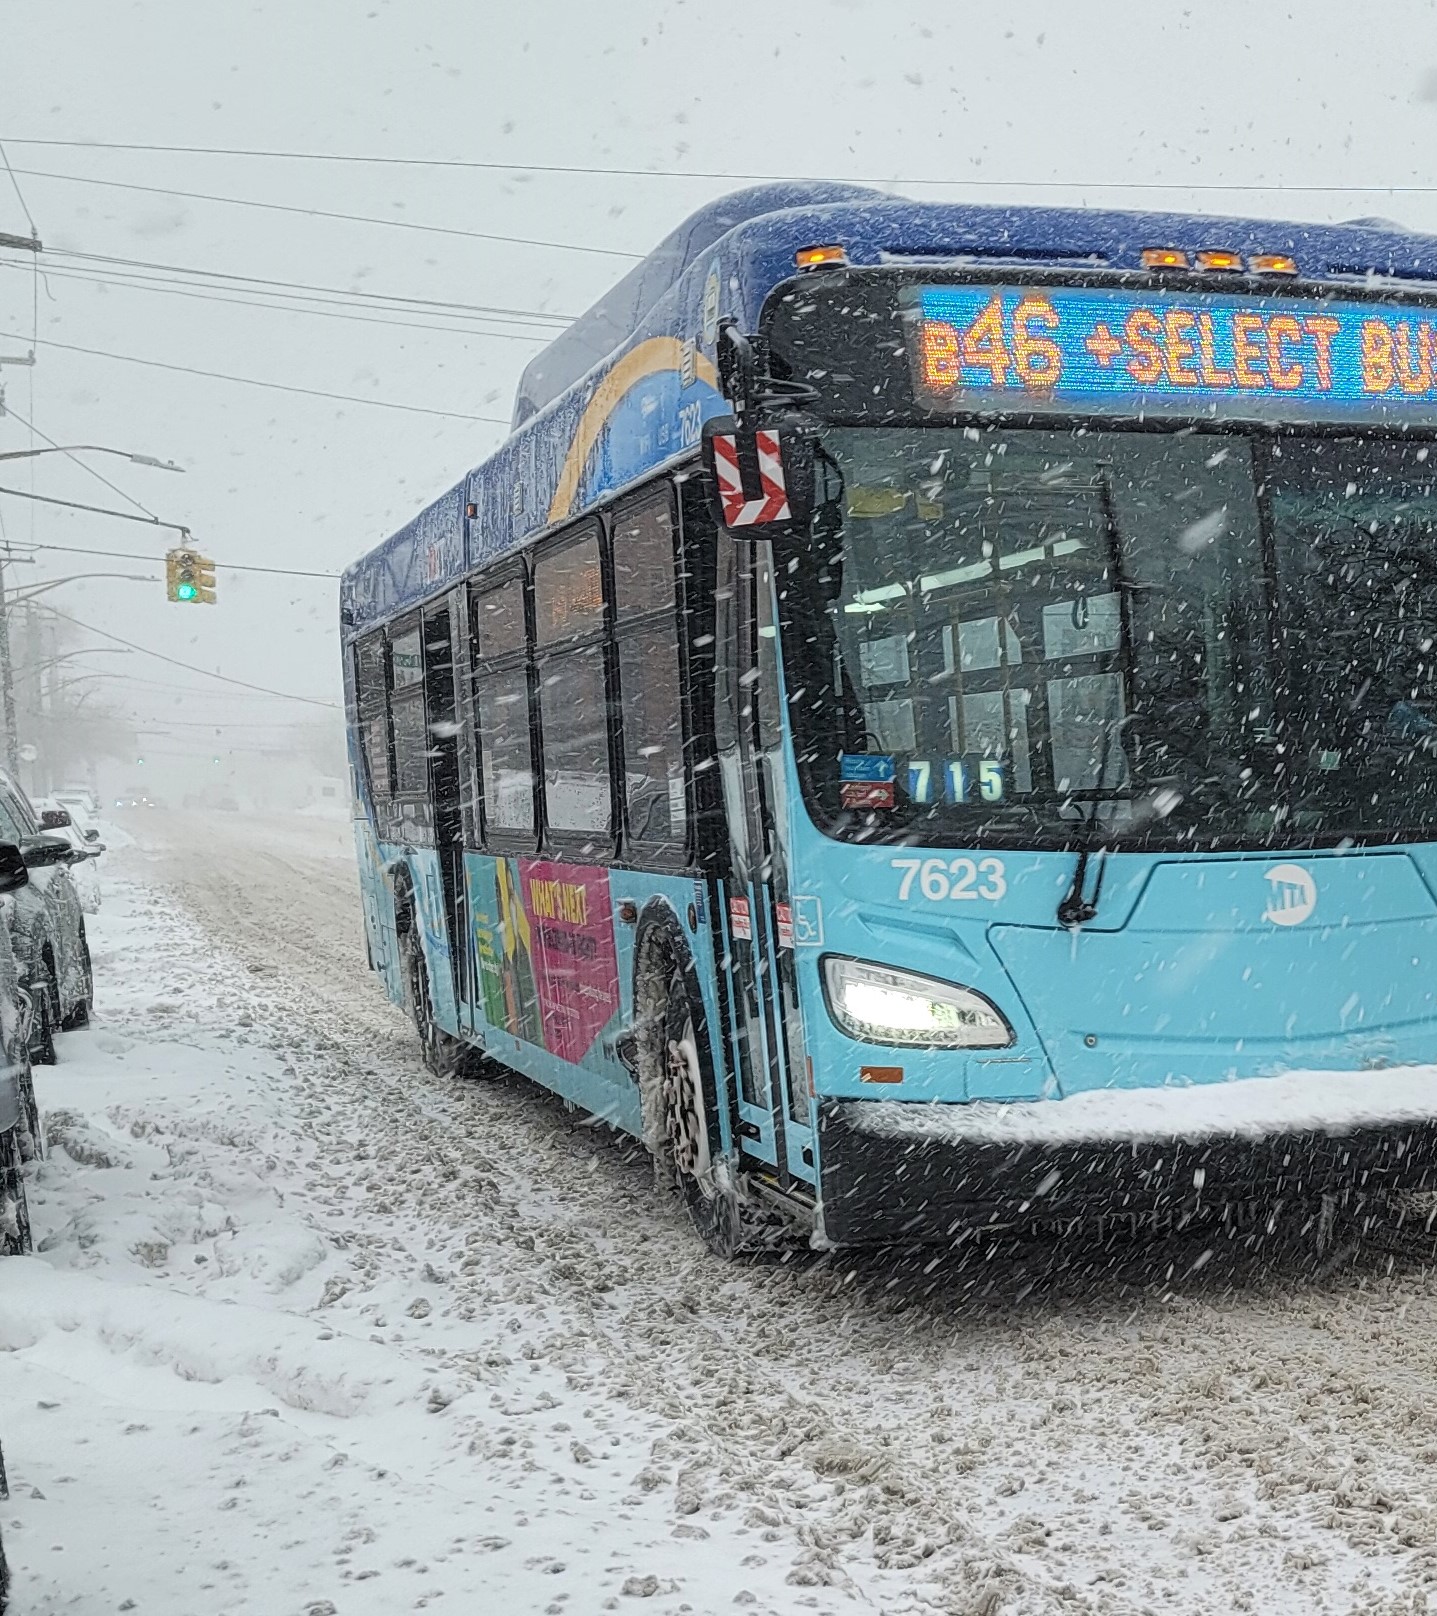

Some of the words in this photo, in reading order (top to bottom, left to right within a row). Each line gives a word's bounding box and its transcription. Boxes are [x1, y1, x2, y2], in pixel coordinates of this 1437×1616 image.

[923, 296, 1061, 387] B46
[679, 400, 702, 449] 7623
[891, 857, 1007, 901] 7623
